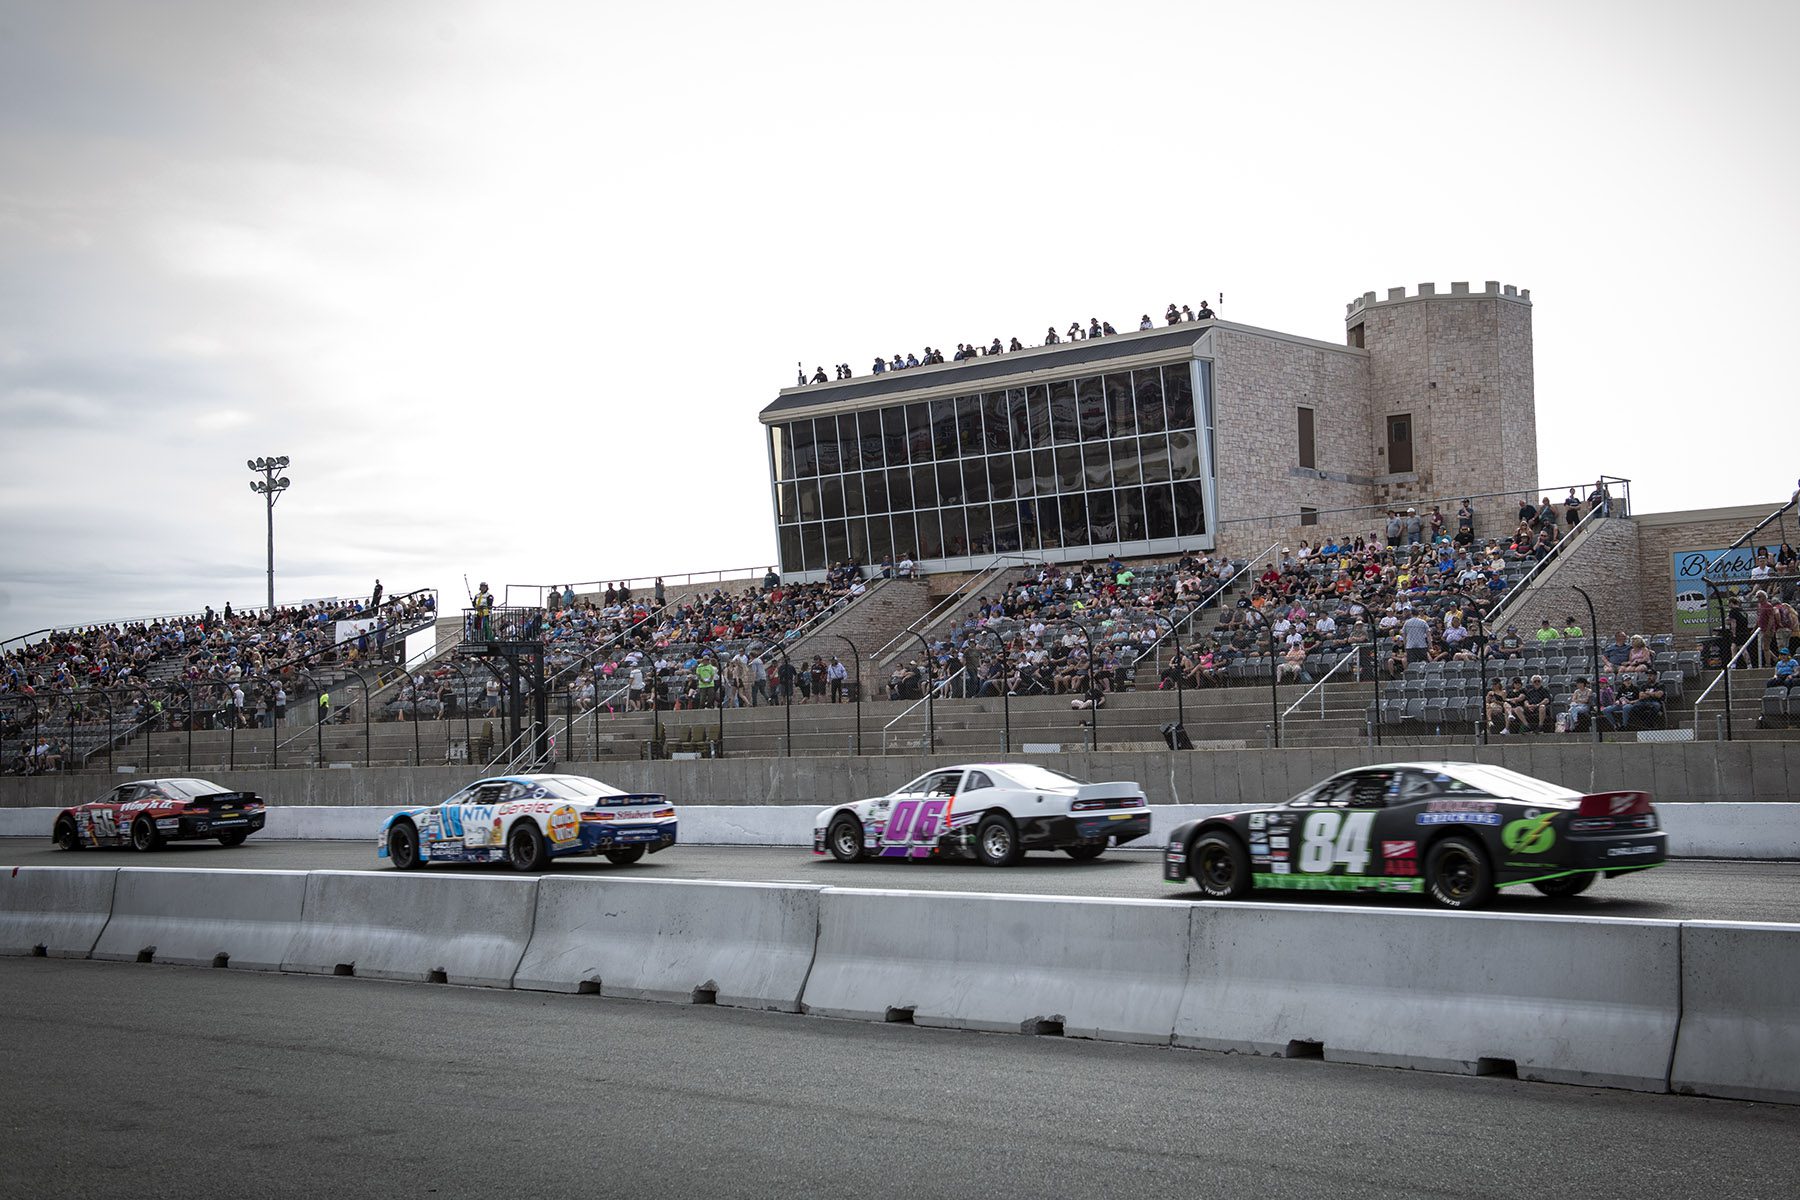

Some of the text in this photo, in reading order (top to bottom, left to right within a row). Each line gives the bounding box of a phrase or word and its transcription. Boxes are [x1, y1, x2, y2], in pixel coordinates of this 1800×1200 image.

[91, 809, 117, 837] 56
[463, 806, 494, 821] NTN
[499, 803, 554, 815] Genatec
[886, 801, 947, 841] 06
[1300, 811, 1377, 874] 84
